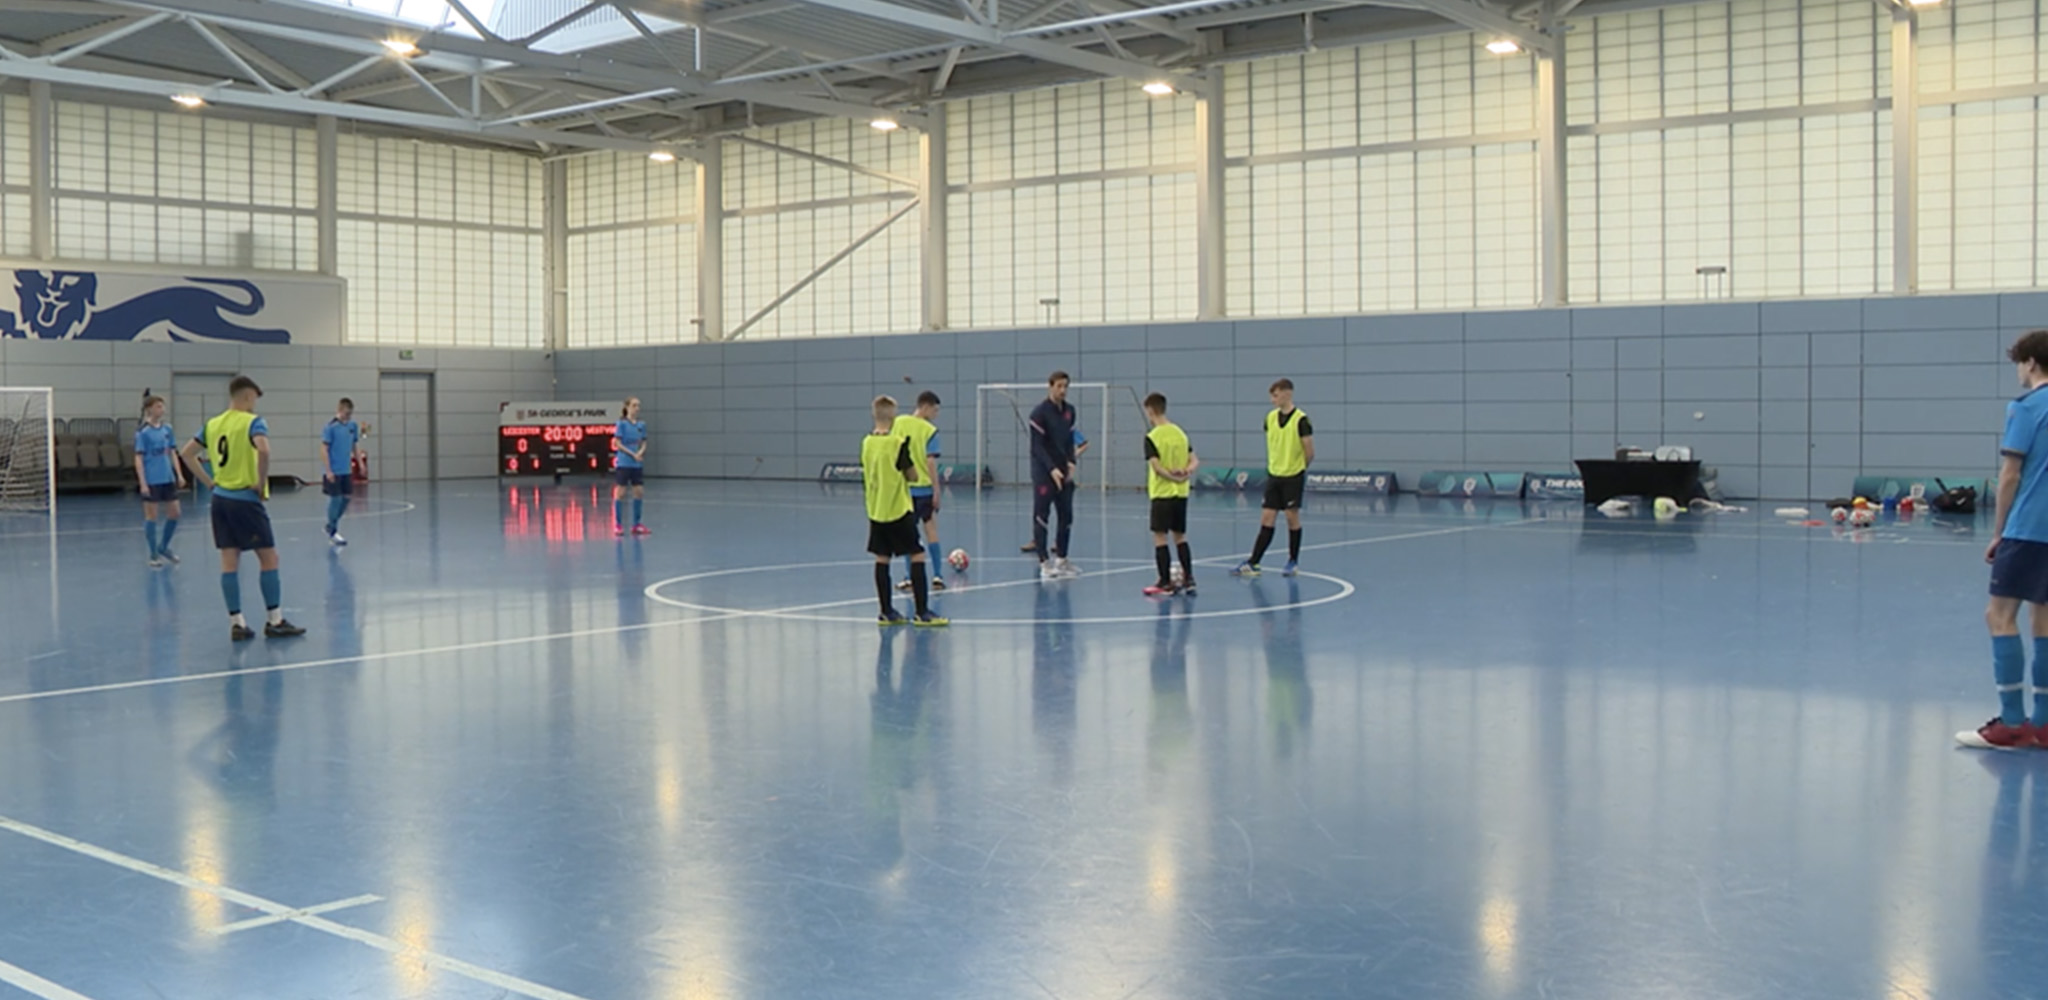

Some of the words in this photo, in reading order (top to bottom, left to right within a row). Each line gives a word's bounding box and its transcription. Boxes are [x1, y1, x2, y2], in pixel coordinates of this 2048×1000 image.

[583, 408, 607, 417] PARK
[543, 426, 583, 441] 20:00
[218, 435, 229, 467] 9
[517, 438, 528, 453] 0
[1307, 475, 1322, 483] THE
[1323, 475, 1346, 483] BOOT
[1346, 475, 1371, 483] ROOM
[1546, 479, 1564, 487] THE
